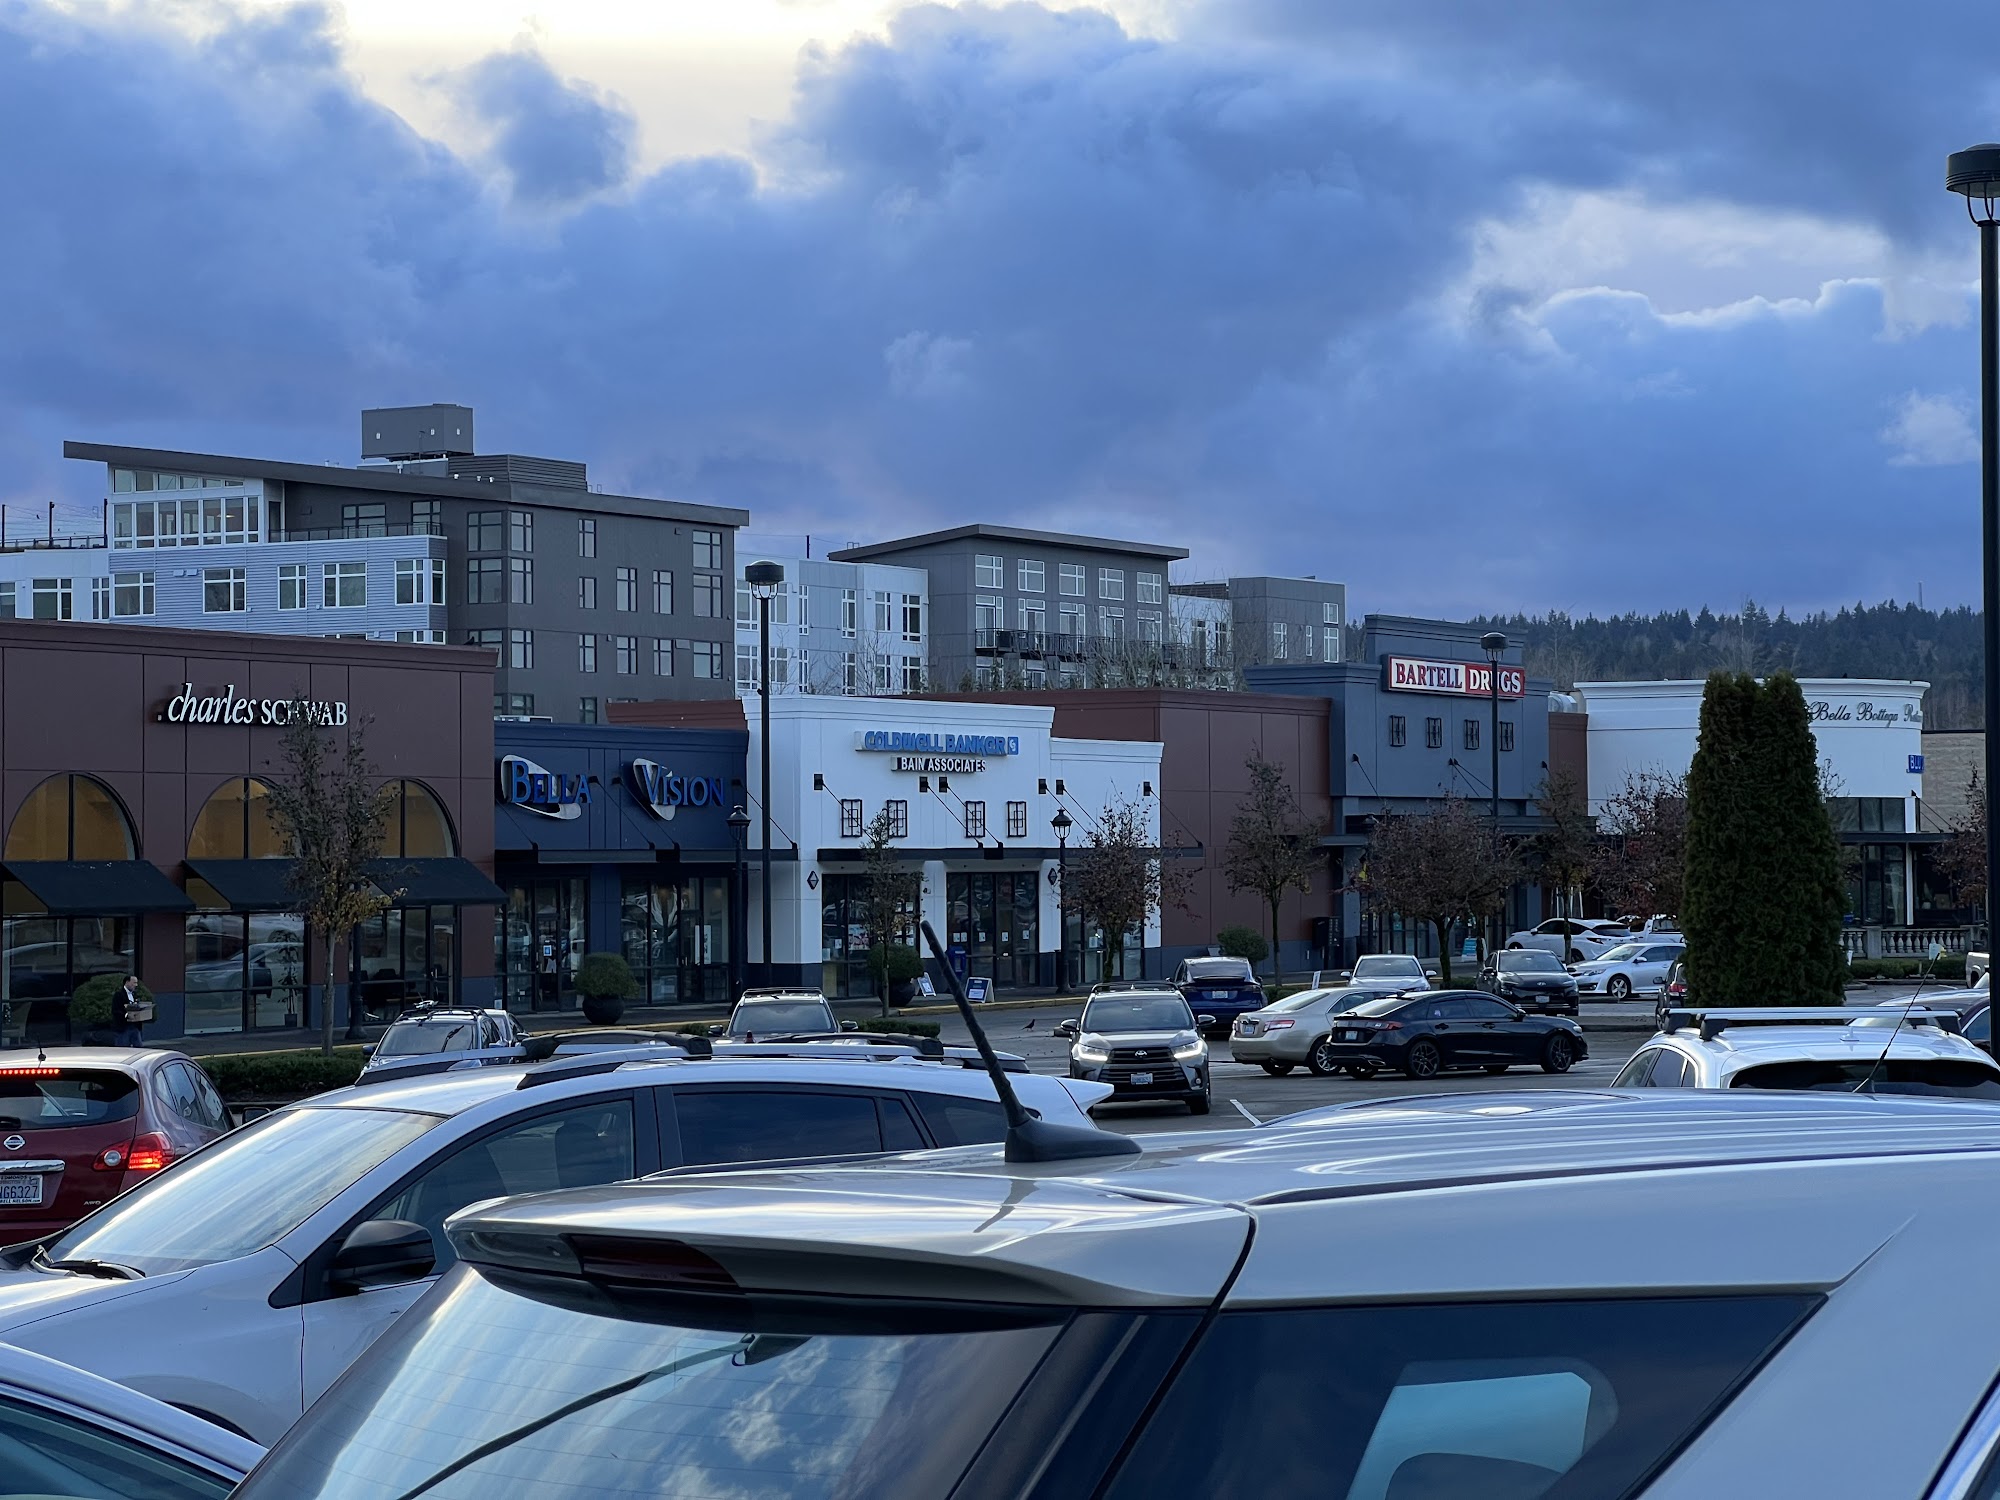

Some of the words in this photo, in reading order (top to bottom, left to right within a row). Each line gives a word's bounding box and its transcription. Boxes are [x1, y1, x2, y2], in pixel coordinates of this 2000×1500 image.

[1396, 663, 1462, 689] BARTELL
[168, 682, 256, 724] charles
[1809, 700, 1851, 721] Bella
[864, 731, 943, 752] COLDWELL
[945, 734, 1006, 756] BANKER
[901, 756, 925, 771] BAIN
[928, 757, 986, 773] ASSOCIATES
[511, 760, 592, 805] BELLA
[642, 764, 724, 807] VISION
